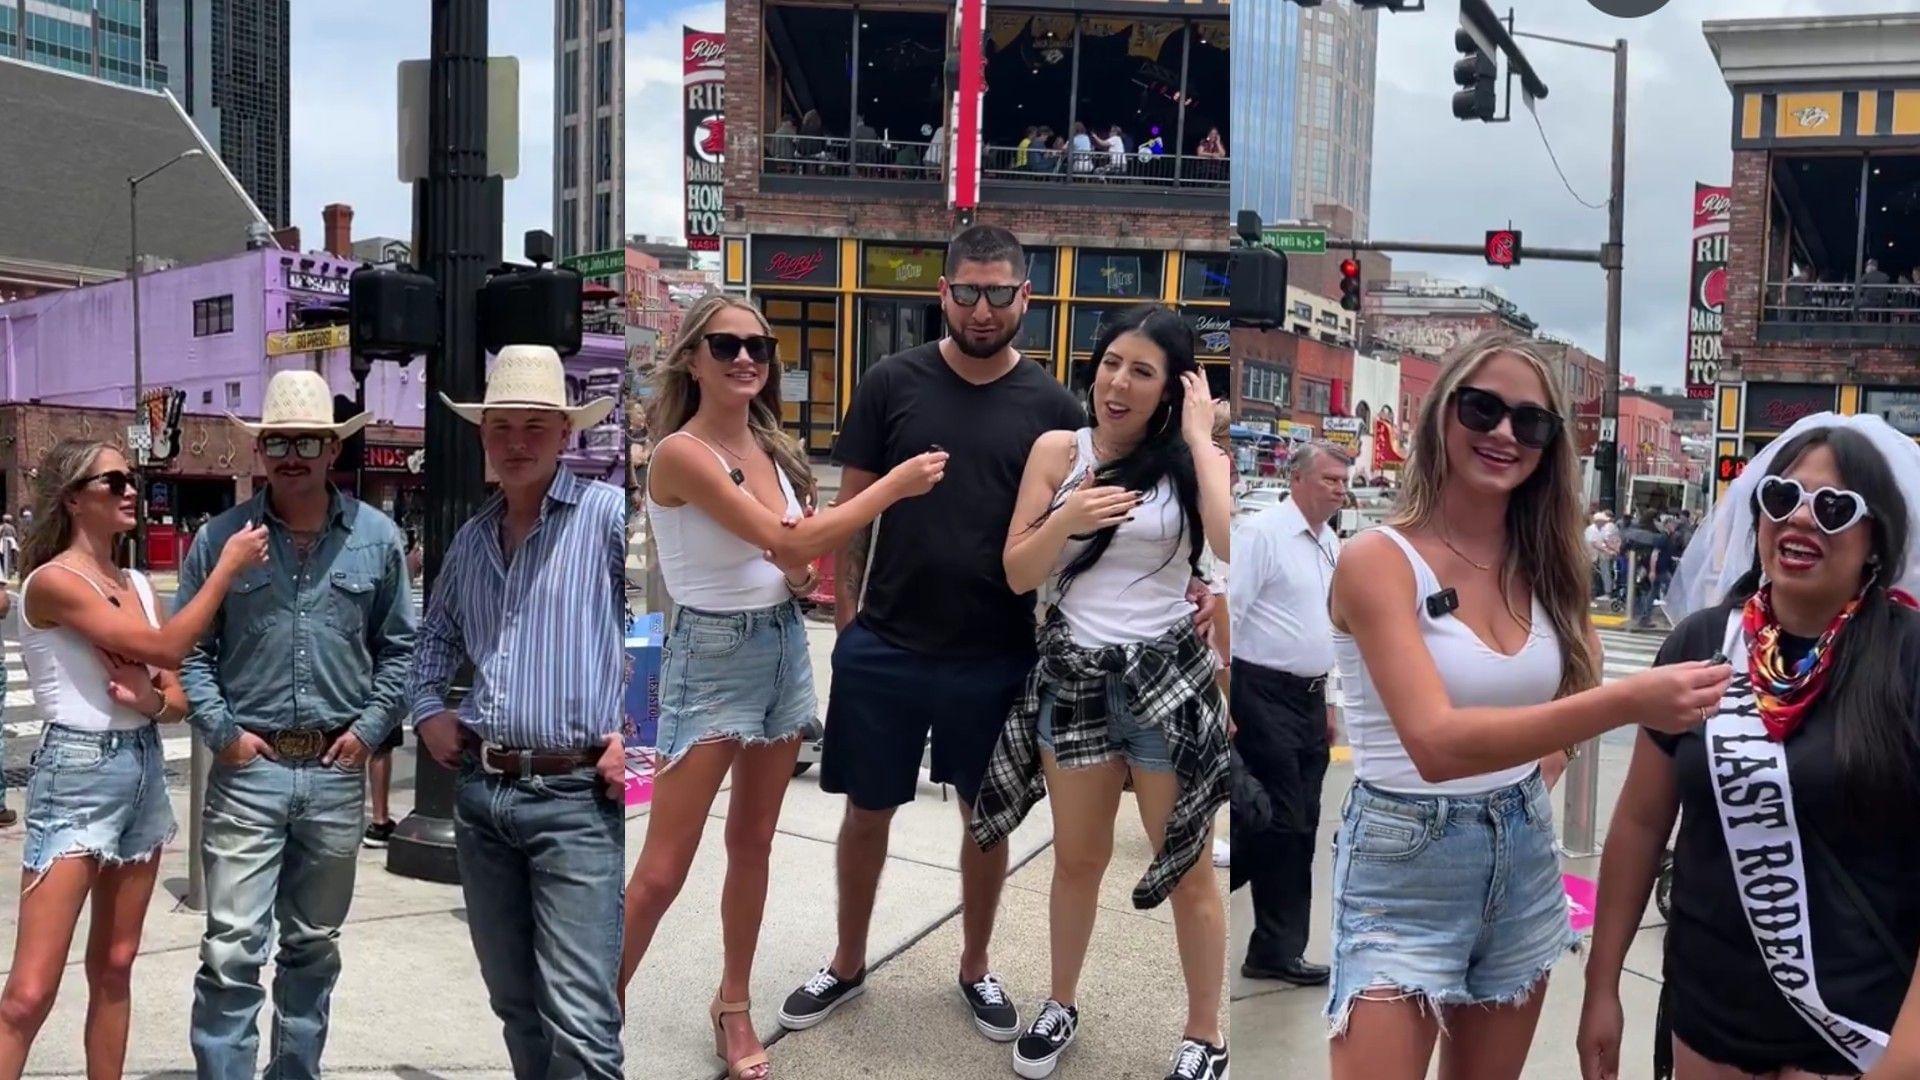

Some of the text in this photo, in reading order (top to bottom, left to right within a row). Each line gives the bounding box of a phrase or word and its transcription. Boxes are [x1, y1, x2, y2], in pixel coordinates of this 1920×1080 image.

[766, 248, 824, 272] Rippy's
[1276, 233, 1295, 247] Lewis
[1306, 234, 1312, 249] S
[1712, 733, 1790, 830] LAST
[1736, 841, 1810, 991] RODEO
